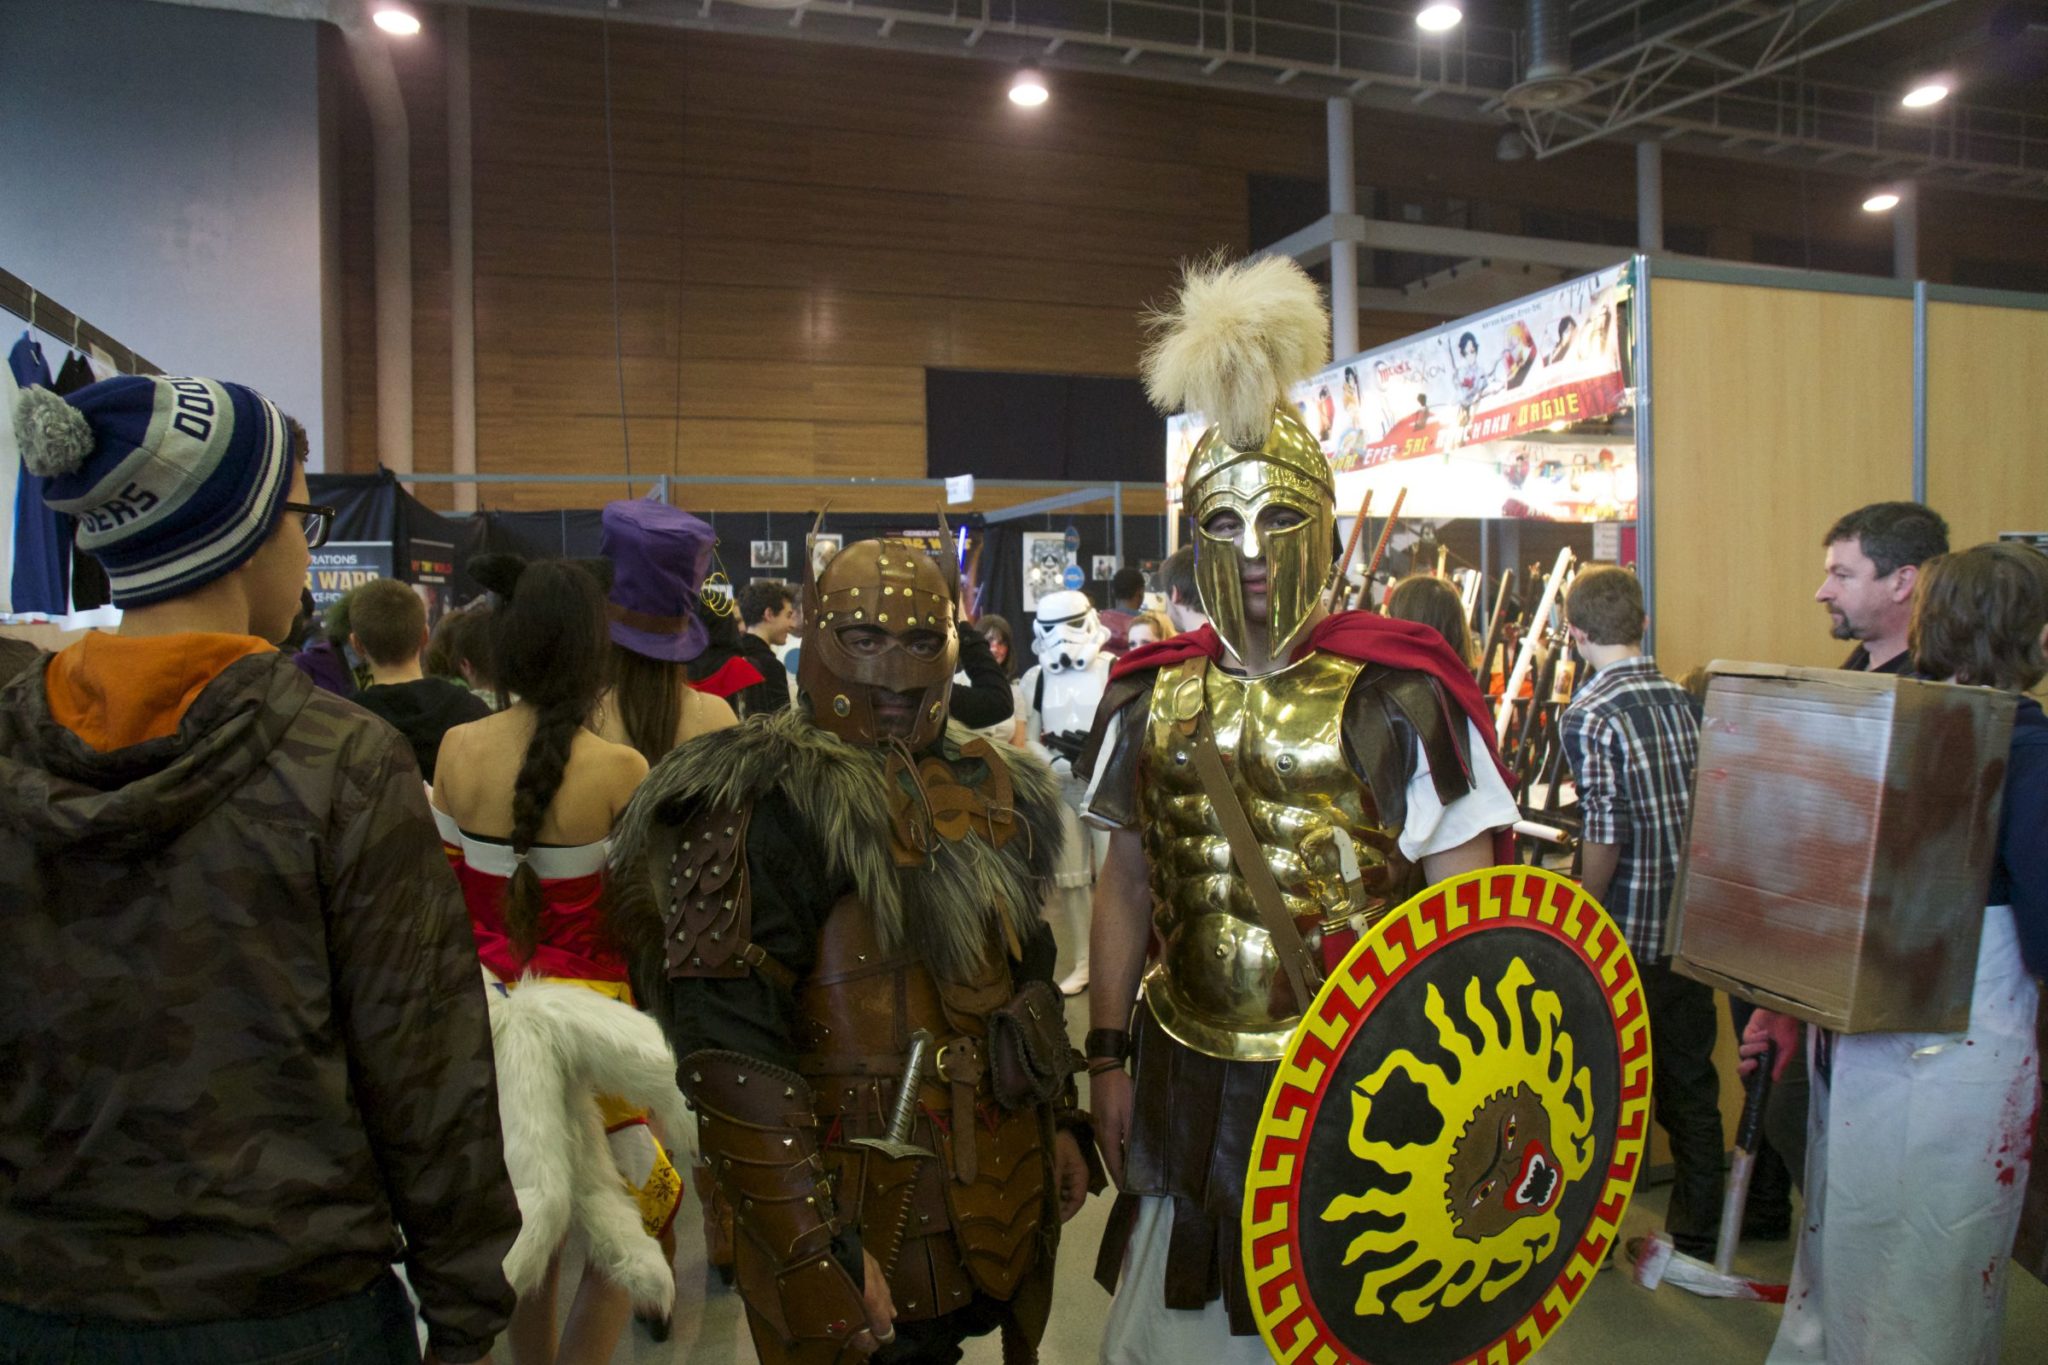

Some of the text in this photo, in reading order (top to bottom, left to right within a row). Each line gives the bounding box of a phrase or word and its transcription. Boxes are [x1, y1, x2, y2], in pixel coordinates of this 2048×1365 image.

[162, 376, 214, 442] DOD
[1517, 393, 1580, 427] DAGUE
[311, 554, 358, 565] RATIONS
